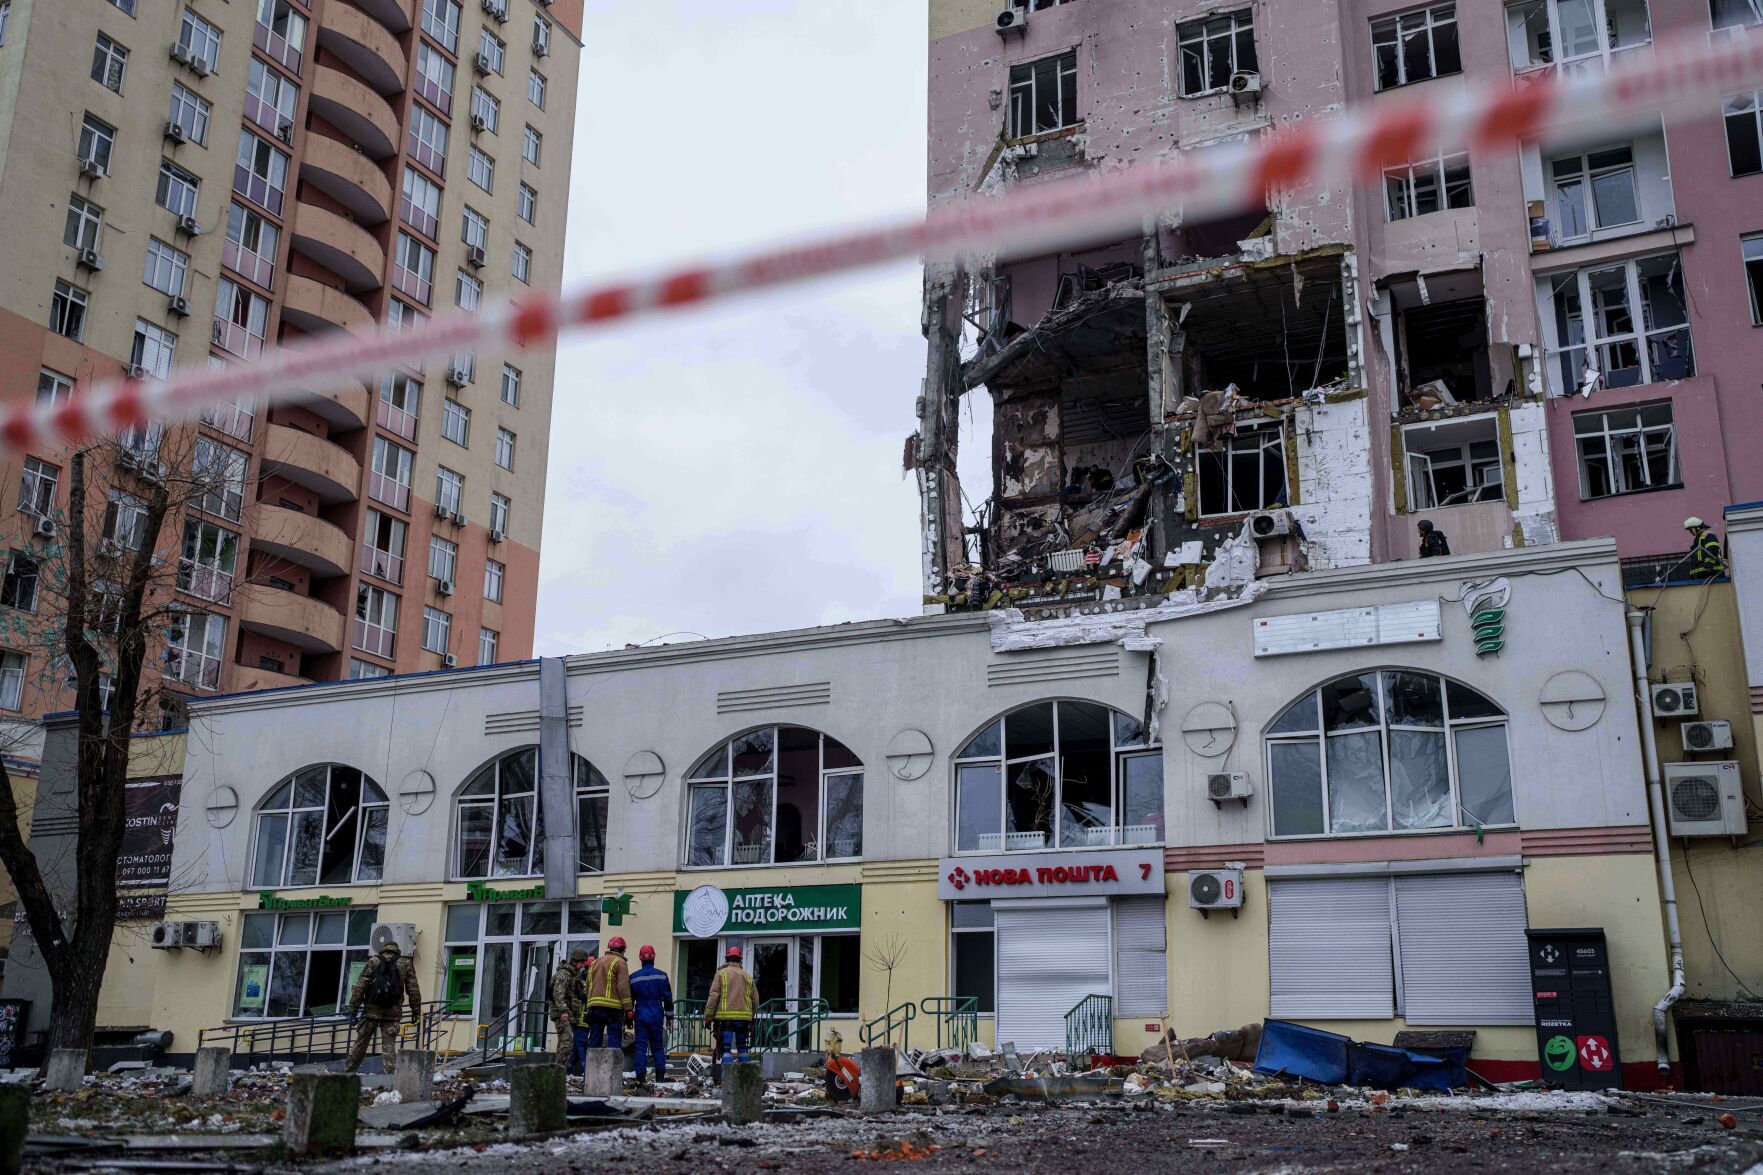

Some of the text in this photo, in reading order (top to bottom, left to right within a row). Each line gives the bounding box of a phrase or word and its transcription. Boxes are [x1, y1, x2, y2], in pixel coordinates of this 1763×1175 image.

[973, 863, 1152, 885] НОВА ПОШТА 7
[483, 884, 545, 903] ПриватБ
[732, 893, 795, 908] АПТЕКА
[731, 906, 848, 924] ПОДОРОЖНИК
